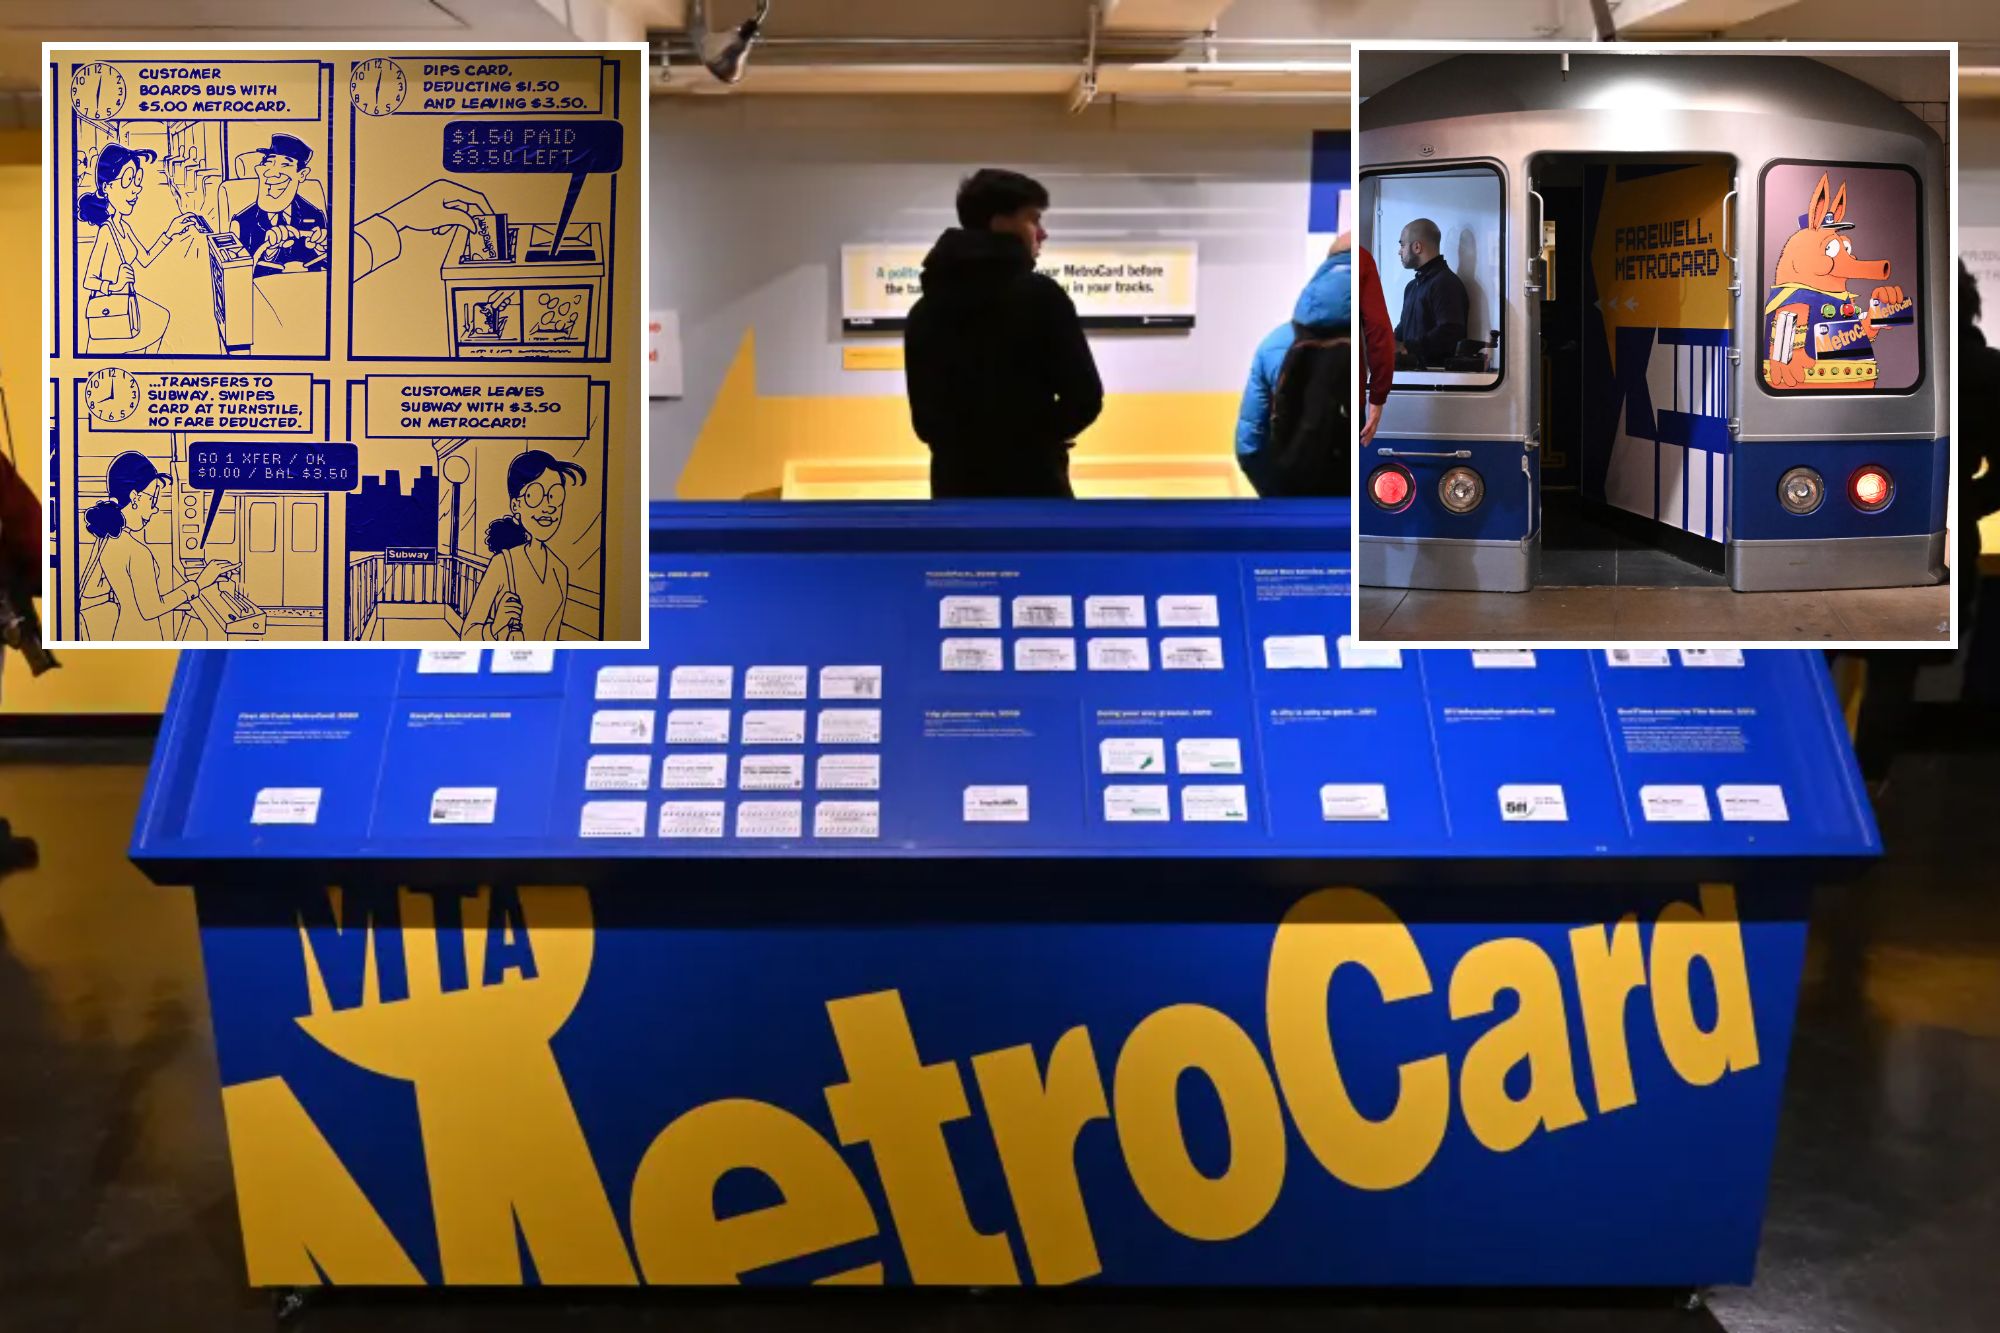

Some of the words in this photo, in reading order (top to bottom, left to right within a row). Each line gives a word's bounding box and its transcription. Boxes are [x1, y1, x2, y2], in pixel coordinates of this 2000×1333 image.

[95, 64, 101, 73] 12
[364, 63, 370, 71] 11
[375, 60, 382, 68] 12
[390, 62, 392, 70] 1
[83, 67, 90, 76] 11
[109, 67, 111, 75] 1
[139, 68, 221, 79] CUSTOMER
[424, 65, 460, 76] DIPS
[465, 64, 512, 76] CARD,
[117, 75, 122, 84] 2
[355, 72, 364, 80] 10
[397, 71, 402, 79] 2
[75, 77, 85, 85] 10
[140, 85, 201, 95] BOARDS
[206, 85, 236, 95] BUS
[240, 85, 276, 95] WITH
[352, 83, 356, 91] 9
[399, 83, 403, 91] 3
[424, 81, 511, 92] DEDUCTING
[516, 81, 559, 91] $1.50
[73, 87, 77, 96] 9
[355, 94, 359, 102] 8
[76, 99, 80, 107] 8
[139, 101, 187, 112] $5.00
[193, 101, 290, 112] METROCARD.
[363, 103, 368, 112] 7
[424, 98, 455, 109] AND
[462, 98, 526, 109] LEAVING
[531, 97, 587, 108] $3.50.
[85, 108, 88, 116] 7
[107, 108, 111, 116] 5
[386, 104, 390, 112] 5
[453, 129, 512, 144] $1.50
[524, 129, 575, 144] PAID
[453, 150, 512, 164] $3.50
[524, 150, 572, 164] LEFT
[1615, 218, 1713, 252] FAREWELL,
[1615, 248, 1720, 281] METROCARD
[1064, 264, 1124, 277] MetroCard
[1127, 264, 1164, 277] before
[885, 283, 904, 295] the
[1073, 281, 1084, 293] in
[1087, 282, 1112, 295] your
[1115, 281, 1154, 293] tracks.
[109, 369, 116, 377] 12
[123, 371, 125, 379] 1
[90, 380, 99, 388] 10
[130, 379, 135, 388] 2
[150, 377, 249, 387] ...TRANSFERS
[253, 377, 272, 387] TO
[132, 391, 136, 399] 3
[148, 390, 214, 401] SUBWAY.
[219, 391, 275, 401] SWIPES
[401, 386, 481, 396] CUSTOMER
[488, 387, 544, 397] LEAVES
[90, 401, 95, 409] 8
[401, 402, 462, 412] SUBWAY
[467, 402, 504, 412] WITH
[510, 402, 561, 413] $3.50
[99, 410, 102, 419] 7
[121, 410, 125, 418] 5
[148, 404, 189, 414] CARD
[195, 404, 213, 414] AT
[218, 404, 302, 418] TURNSTILE,
[109, 412, 114, 420] 6
[149, 417, 169, 426] NO
[175, 417, 214, 427] FARE
[220, 417, 301, 427] DEDUCTED.
[401, 418, 421, 427] ON
[428, 417, 526, 428] METROCARD!
[199, 453, 217, 463] GO
[227, 453, 234, 463] 1
[243, 454, 280, 464] XFER
[307, 454, 325, 464] OK
[199, 467, 239, 478] $0.00
[266, 468, 293, 478] BAL
[303, 468, 347, 479] $3.50
[388, 550, 428, 562] Subway
[294, 886, 540, 1016] MTA
[222, 885, 1760, 1286] MetroCard
